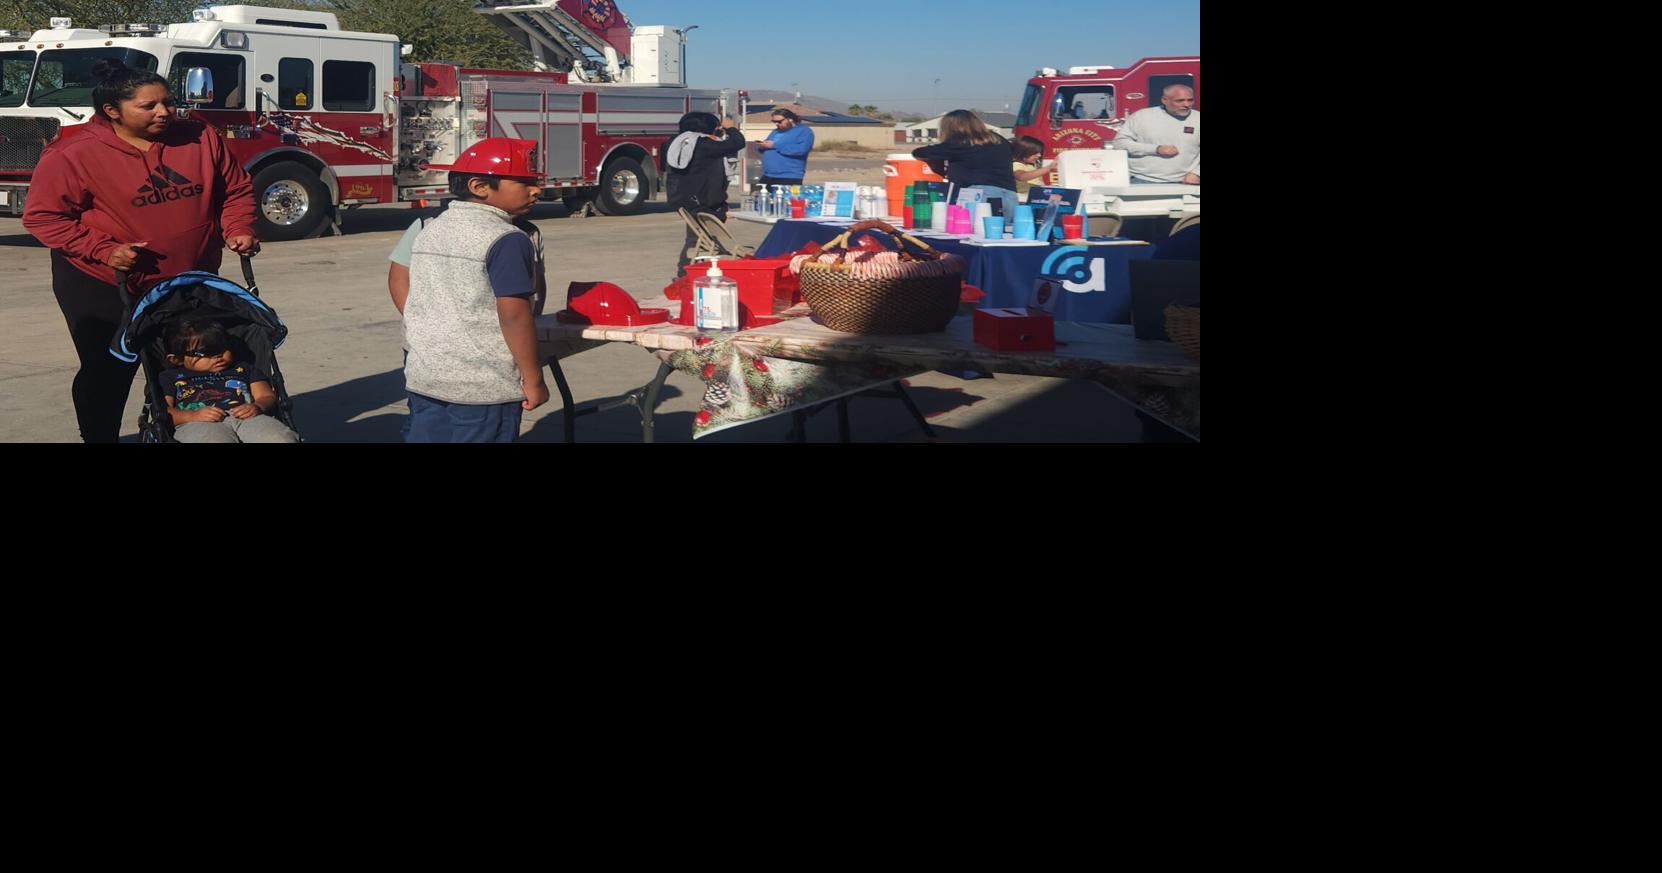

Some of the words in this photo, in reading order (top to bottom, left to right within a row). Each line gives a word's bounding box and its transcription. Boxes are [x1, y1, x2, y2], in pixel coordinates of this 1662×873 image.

[1052, 127, 1084, 141] ARIZONA
[1084, 129, 1102, 141] CITY
[130, 184, 204, 207] adidas
